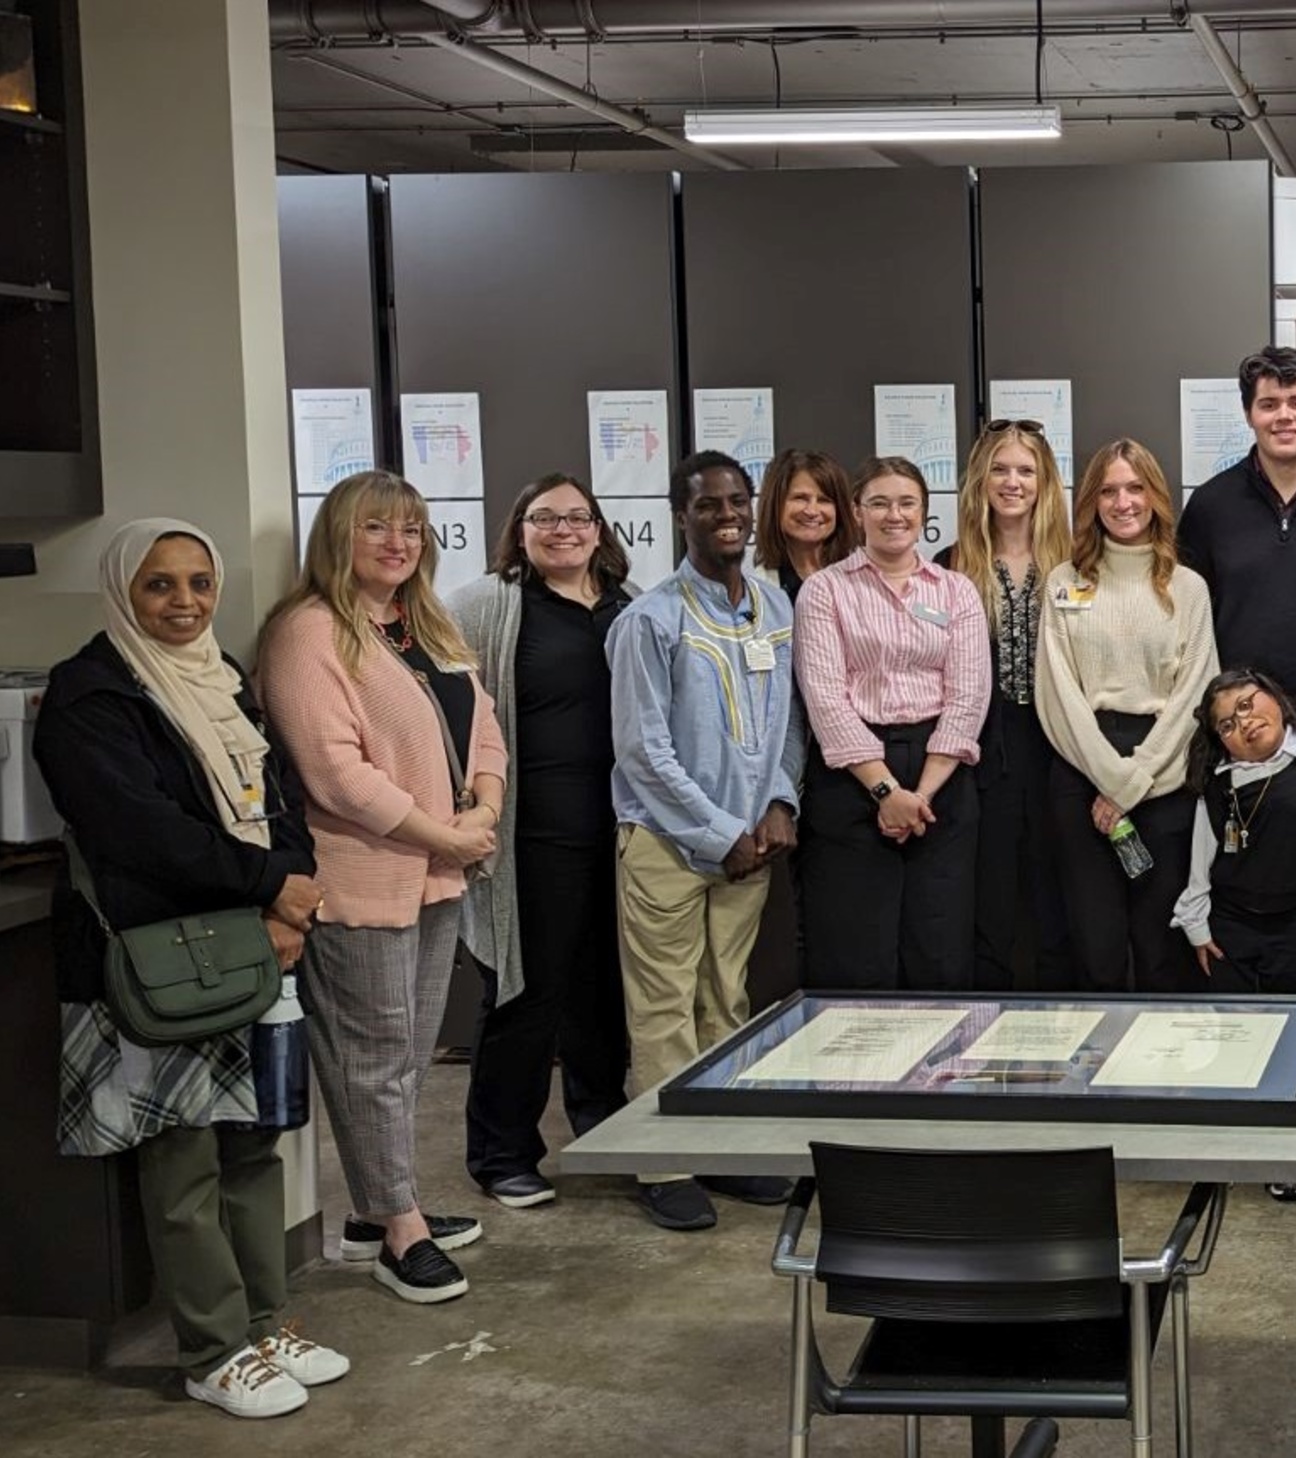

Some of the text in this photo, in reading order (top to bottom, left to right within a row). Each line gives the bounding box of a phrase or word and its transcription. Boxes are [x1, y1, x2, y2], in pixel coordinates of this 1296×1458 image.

[428, 522, 467, 550] N3
[613, 520, 655, 548] N4
[924, 515, 941, 543] 6
